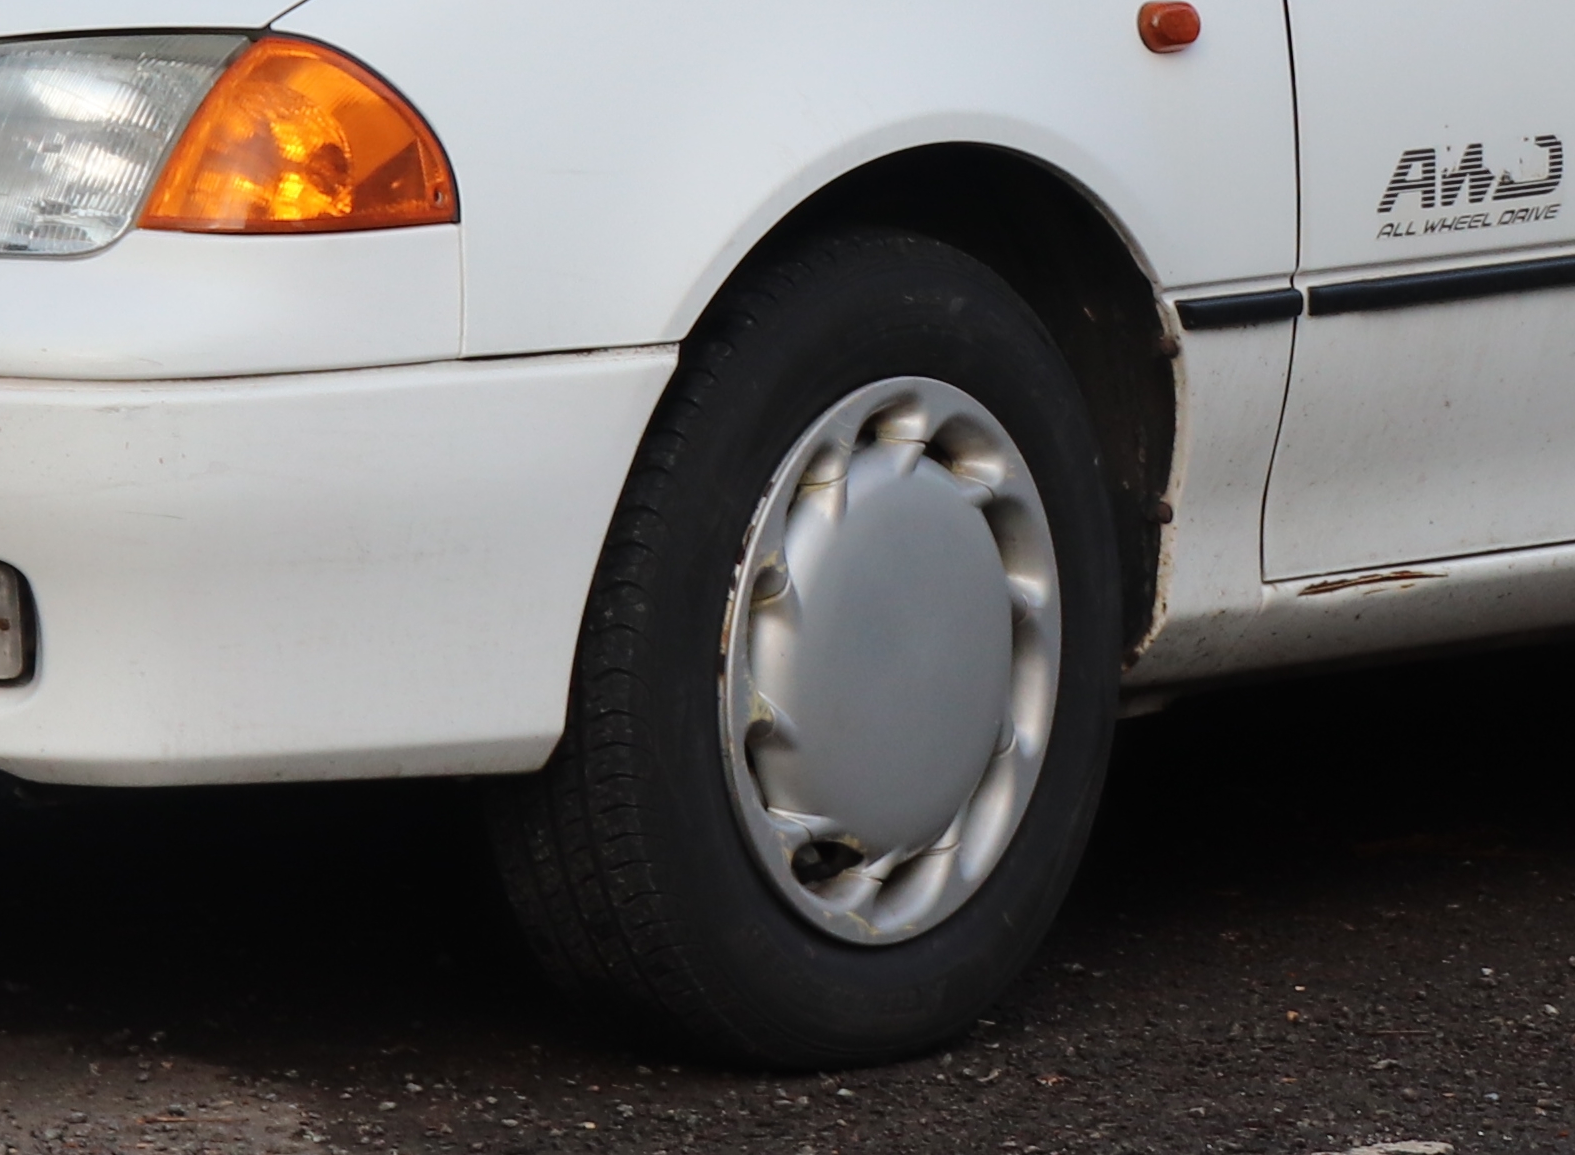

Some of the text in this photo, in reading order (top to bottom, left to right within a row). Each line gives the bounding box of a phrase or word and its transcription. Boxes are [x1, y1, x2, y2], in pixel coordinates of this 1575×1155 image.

[1377, 203, 1561, 238] ALL WHEEL DRIVE
